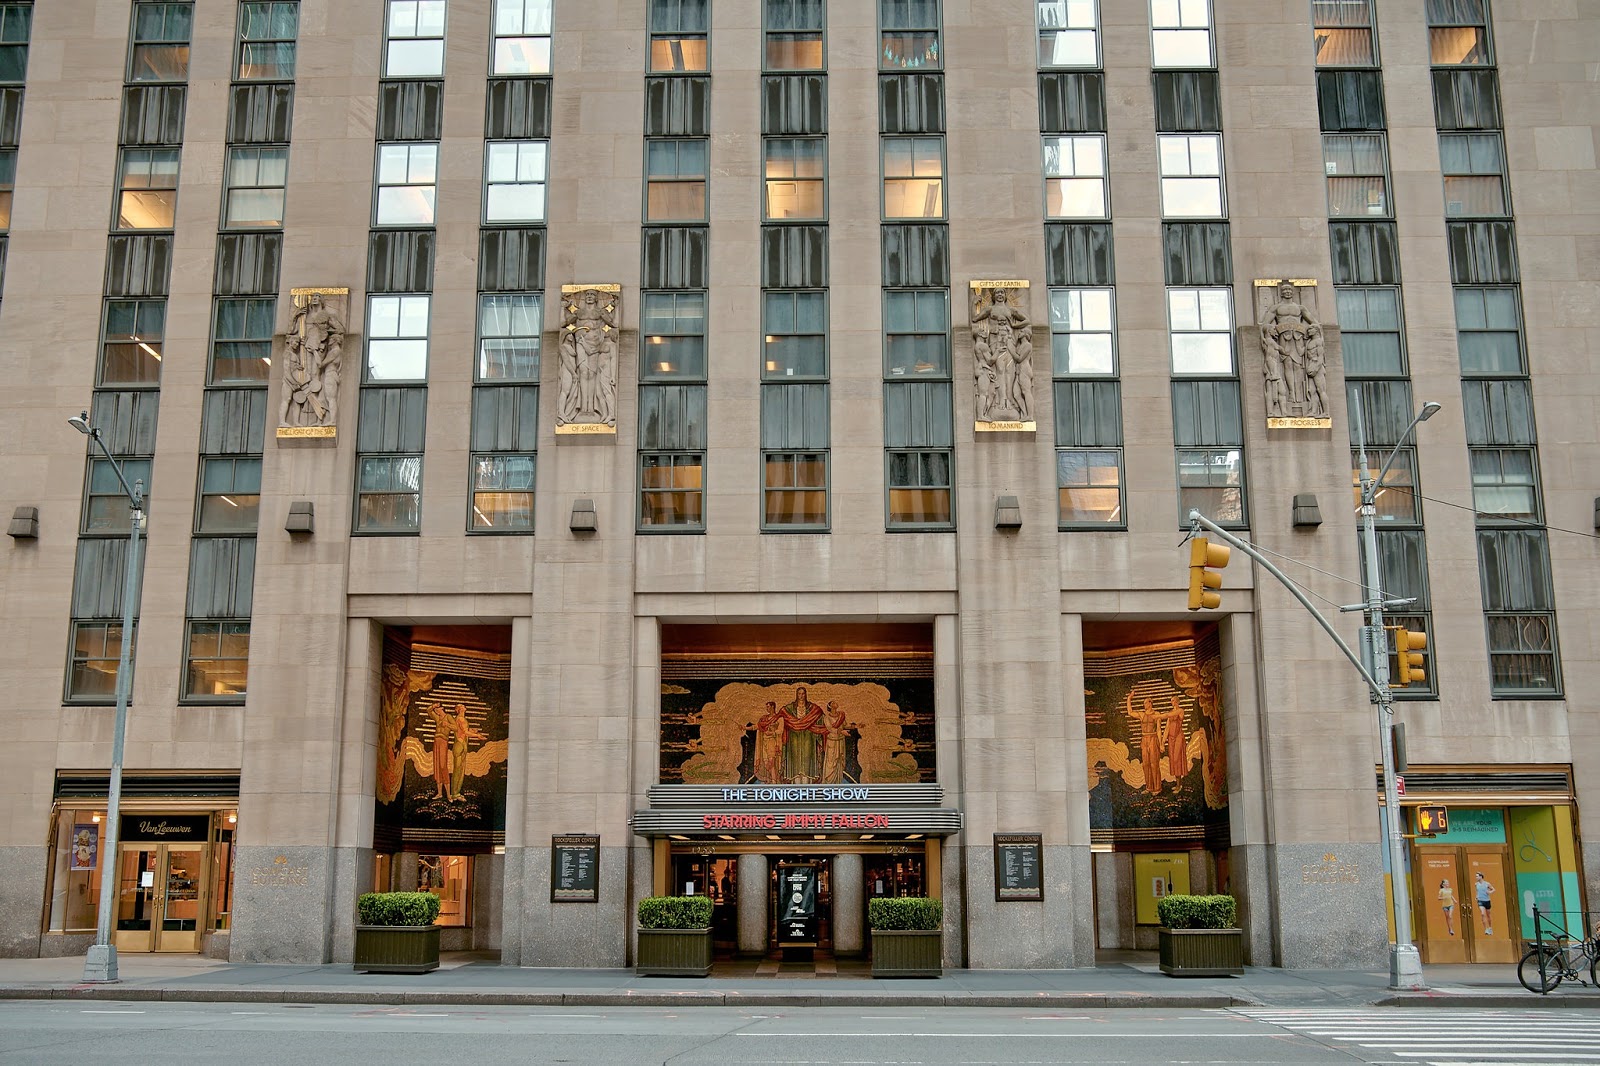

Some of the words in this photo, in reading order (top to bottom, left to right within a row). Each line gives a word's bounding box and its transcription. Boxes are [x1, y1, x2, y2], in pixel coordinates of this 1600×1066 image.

[721, 788, 748, 801] THE
[753, 788, 818, 801] TONIGHT
[822, 787, 870, 801] SHOW
[703, 815, 776, 829] STARRING
[781, 815, 827, 828] JIMMY
[831, 814, 888, 828] FALLON
[1437, 811, 1446, 828] 6
[140, 820, 157, 833] Van
[154, 821, 192, 835] Leeuwen
[252, 867, 308, 877] COMCAST
[1302, 864, 1359, 874] COMCAST
[252, 877, 308, 887] BUILDING
[1303, 874, 1360, 884] BUILDING
